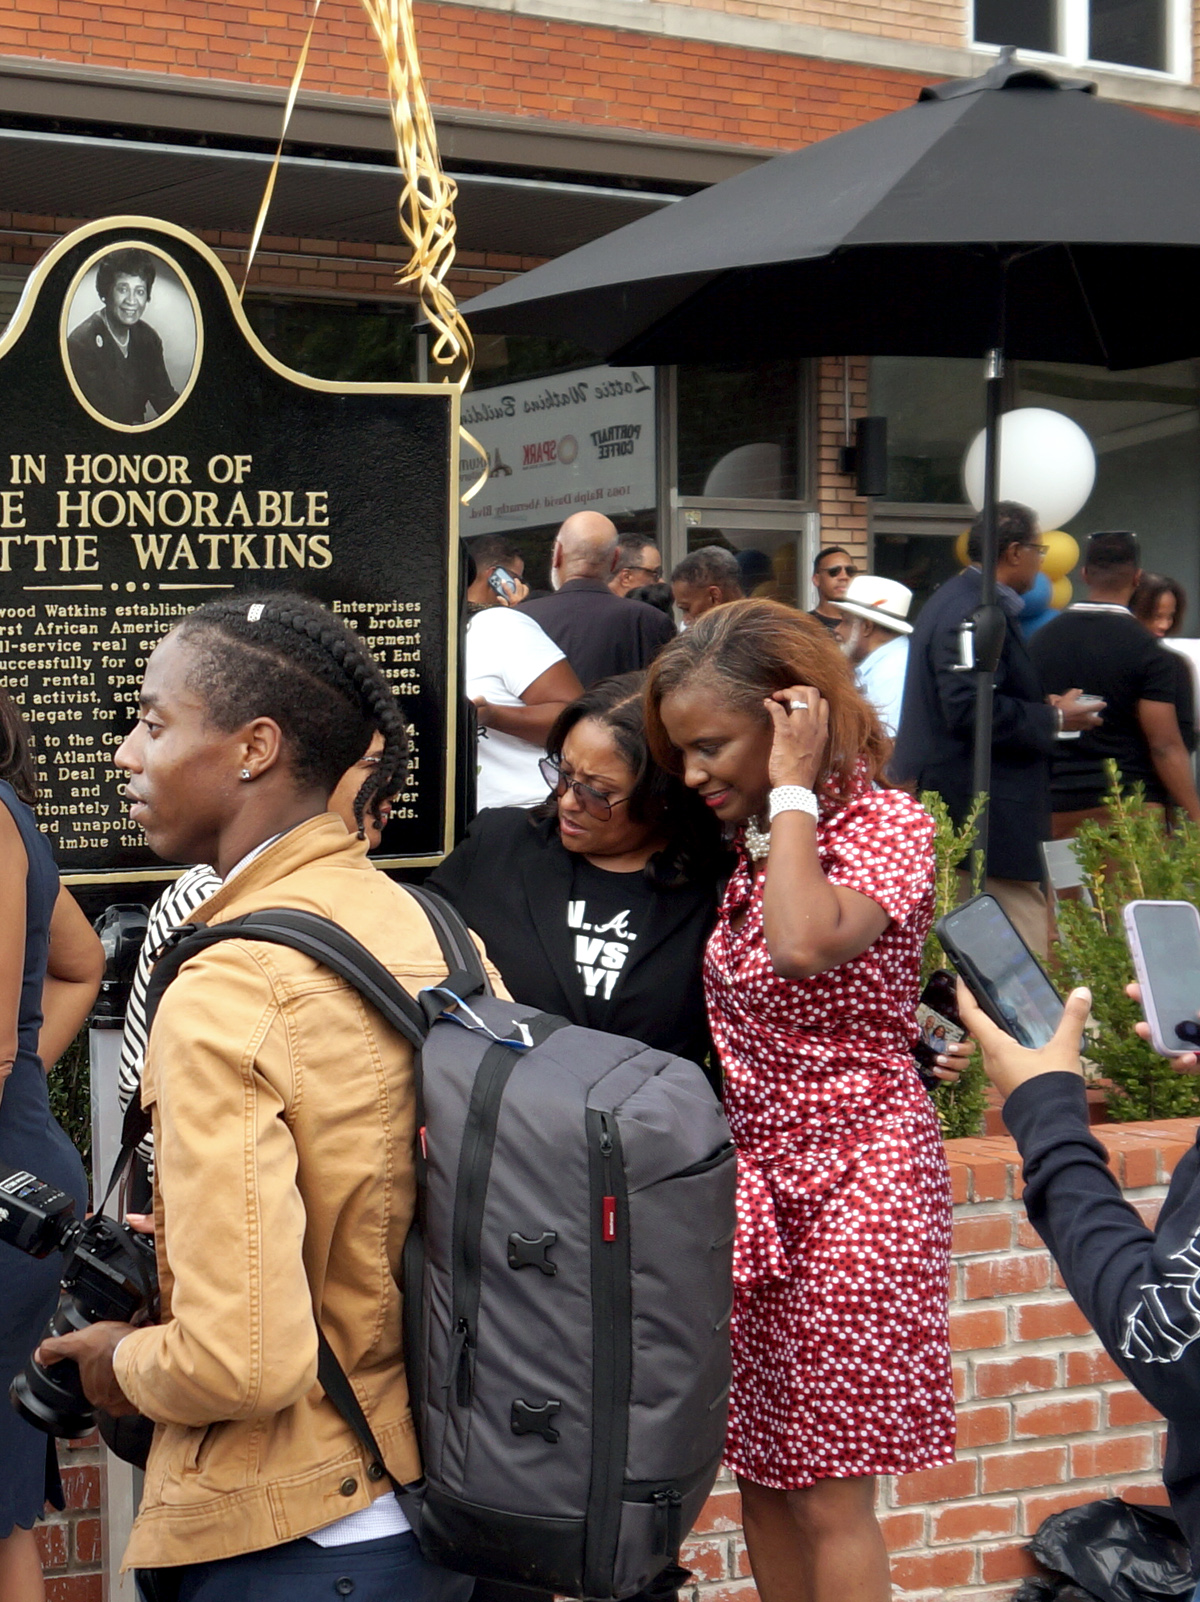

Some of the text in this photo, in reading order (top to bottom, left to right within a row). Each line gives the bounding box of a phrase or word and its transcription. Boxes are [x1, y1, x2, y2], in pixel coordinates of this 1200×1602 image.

[10, 453, 253, 484] IN HONOR OF
[56, 489, 330, 528] HONORABLE
[130, 533, 333, 571] WATKINS
[45, 604, 108, 618] Watkins
[332, 600, 421, 615] Enterprises
[34, 622, 99, 636] African
[343, 617, 359, 629] te
[368, 616, 421, 629] broker
[92, 638, 127, 651] real
[101, 655, 127, 668] for
[392, 649, 421, 662] End
[42, 673, 96, 687] rental
[107, 674, 145, 688] spac
[33, 690, 102, 705] activist,
[113, 691, 141, 703] act
[391, 682, 421, 695] atic
[21, 708, 83, 724] elegate
[92, 707, 117, 721] for
[44, 734, 61, 747] to
[67, 733, 94, 747] the
[53, 751, 112, 765] Atlanta
[58, 767, 95, 781] Deal
[104, 769, 131, 782] pre
[407, 756, 420, 769] al
[35, 788, 53, 799] on
[71, 785, 101, 798] and
[32, 802, 110, 817] tionately
[36, 820, 60, 833] ed
[72, 818, 145, 833] unapolog
[386, 807, 419, 819] rds.
[59, 836, 109, 849] imbue
[575, 935, 629, 969] VS
